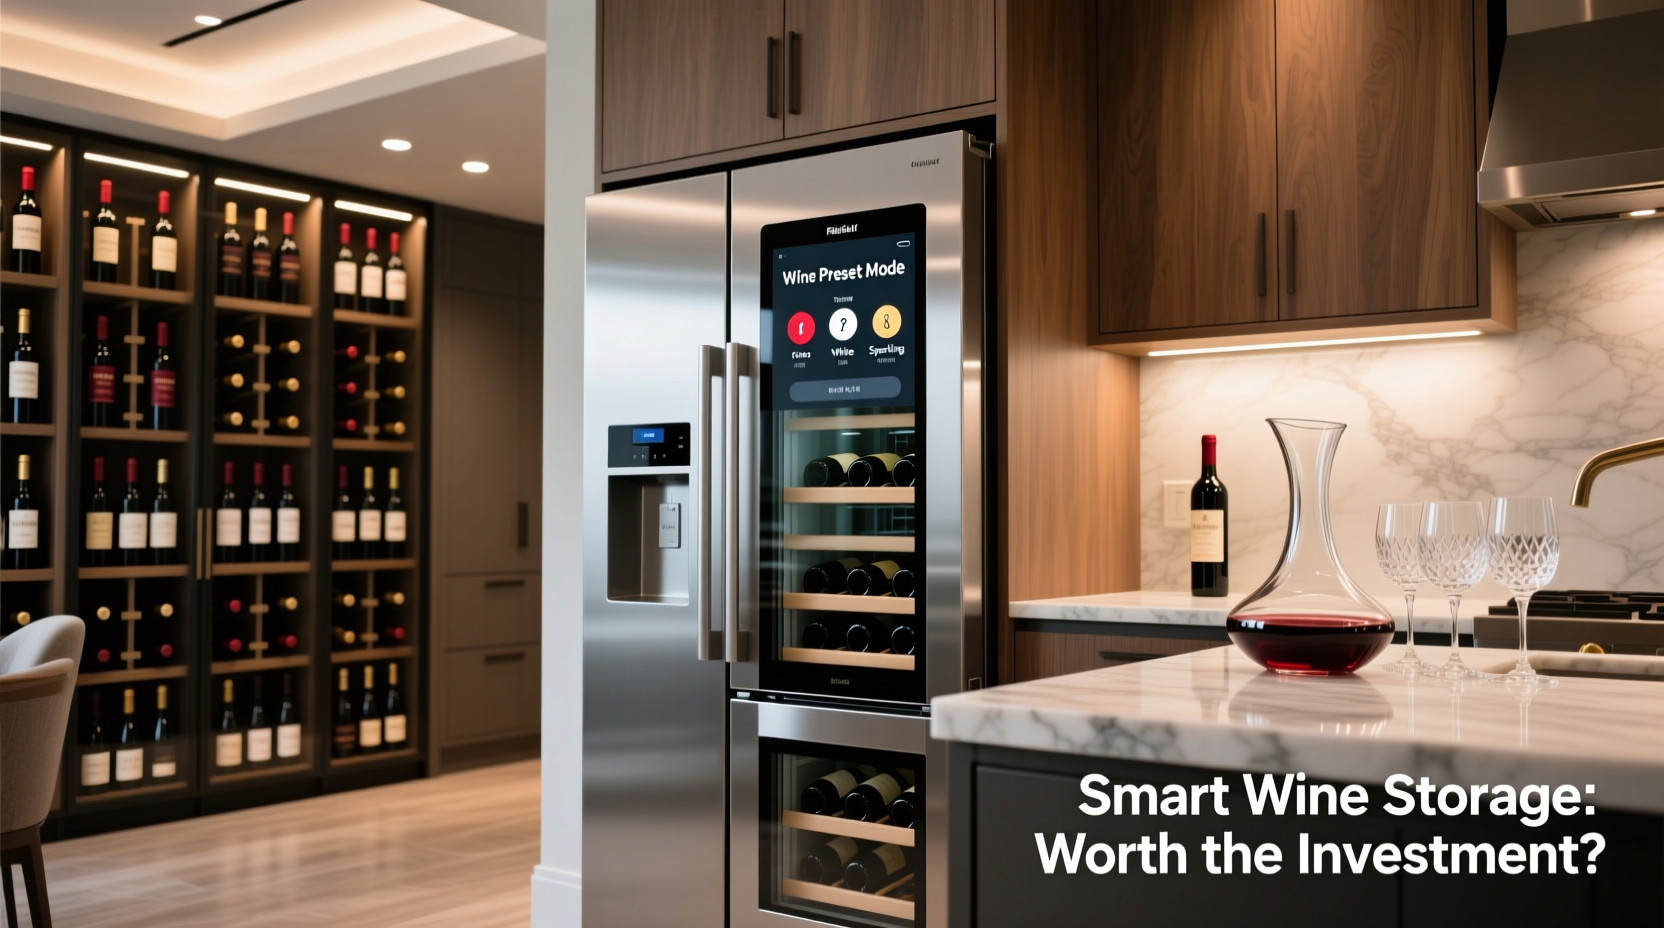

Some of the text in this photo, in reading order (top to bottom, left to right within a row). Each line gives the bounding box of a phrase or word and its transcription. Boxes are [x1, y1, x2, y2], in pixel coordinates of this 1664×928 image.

[783, 260, 905, 285] Wine Preset Mode
